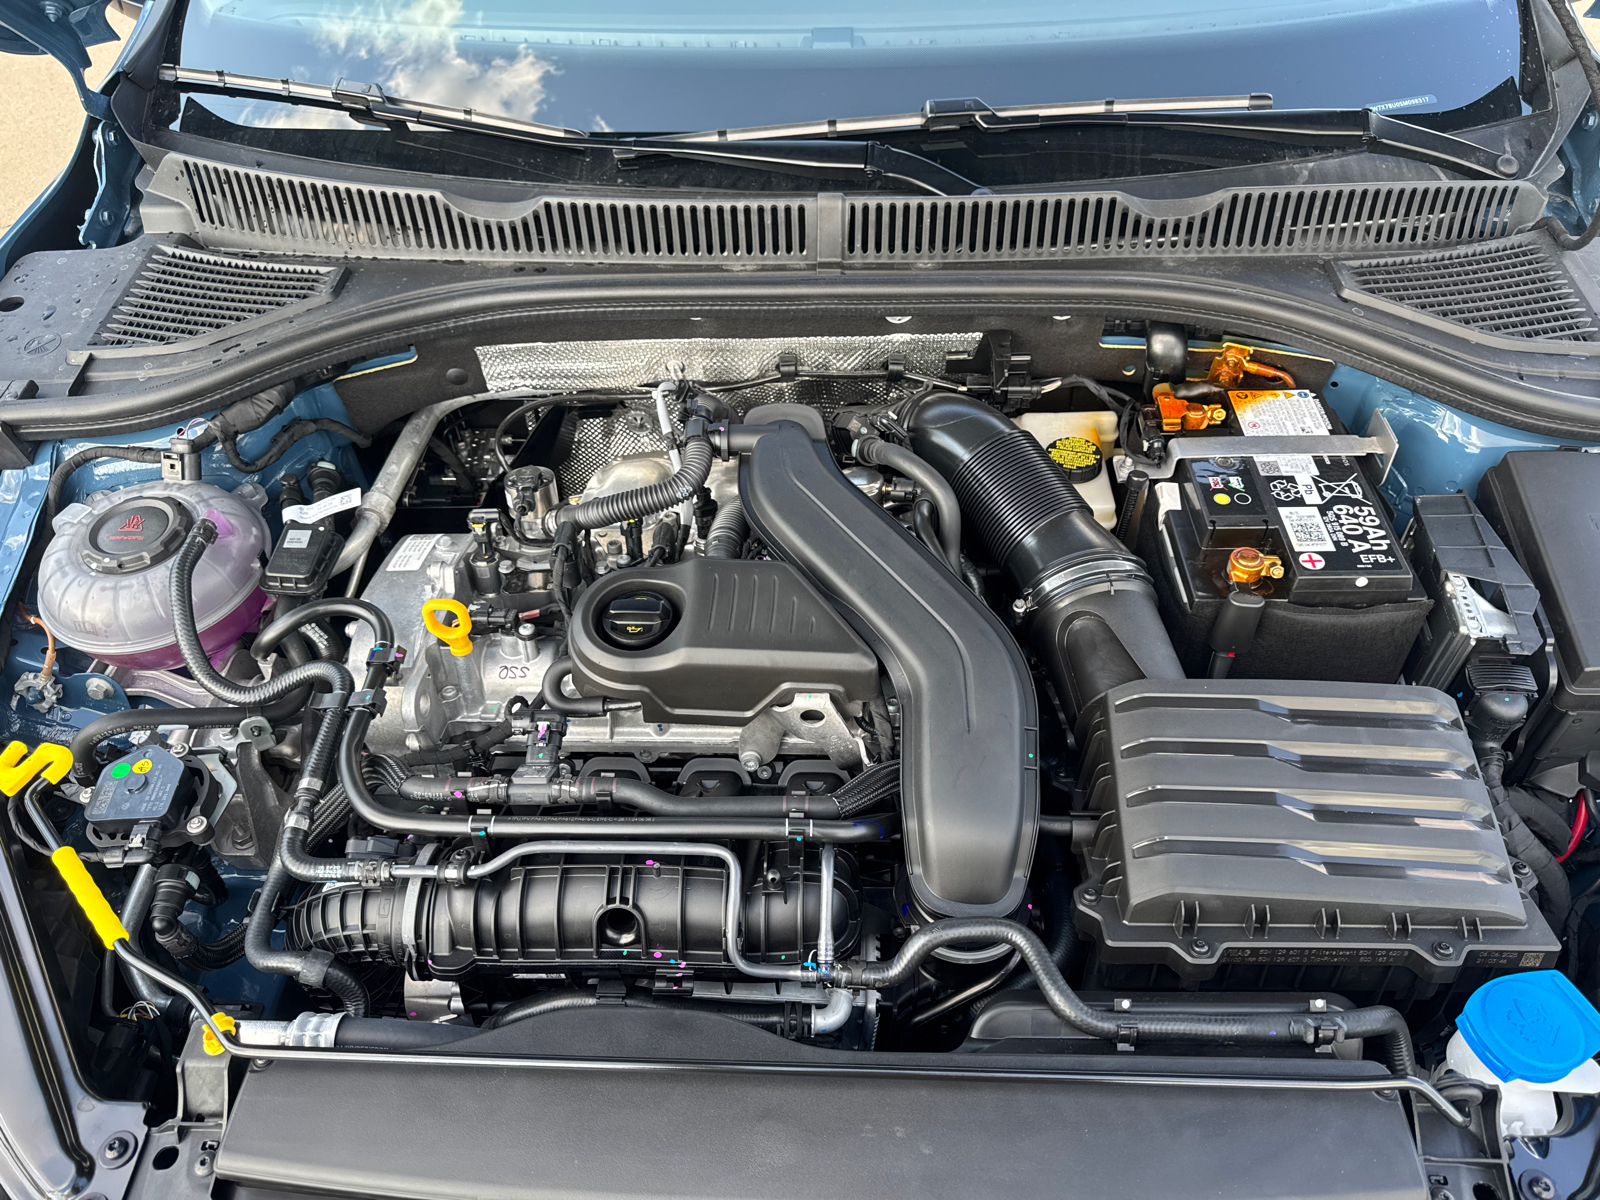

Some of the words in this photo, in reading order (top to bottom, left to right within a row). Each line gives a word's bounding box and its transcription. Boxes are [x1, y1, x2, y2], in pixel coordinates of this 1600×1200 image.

[1302, 484, 1314, 495] Pb
[1333, 505, 1363, 535] 640
[1354, 506, 1391, 550] 59Ah
[1347, 539, 1371, 553] A
[1359, 554, 1396, 563] EFB+
